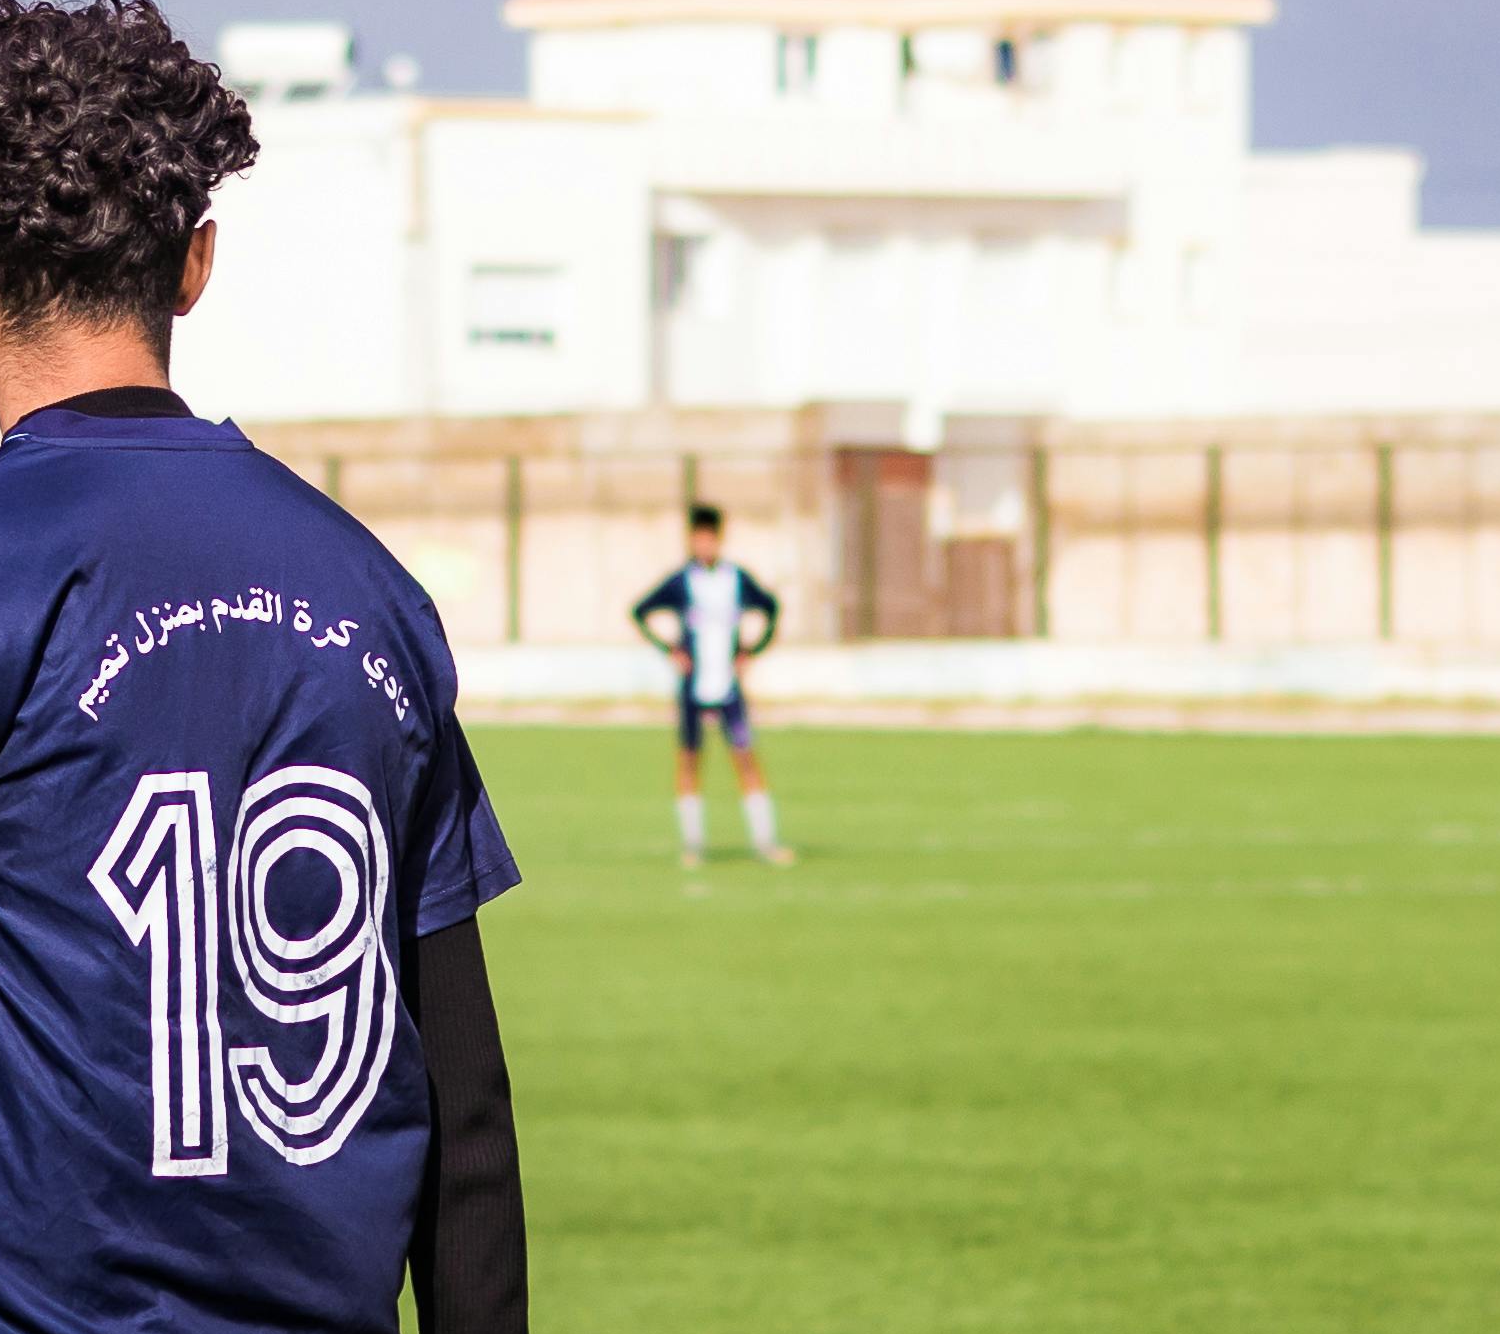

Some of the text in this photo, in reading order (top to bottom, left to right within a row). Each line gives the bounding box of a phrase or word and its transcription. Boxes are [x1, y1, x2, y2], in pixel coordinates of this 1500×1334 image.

[78, 587, 410, 722] نادي كرة القدم بمنزل تميم
[87, 765, 398, 1177] 19
